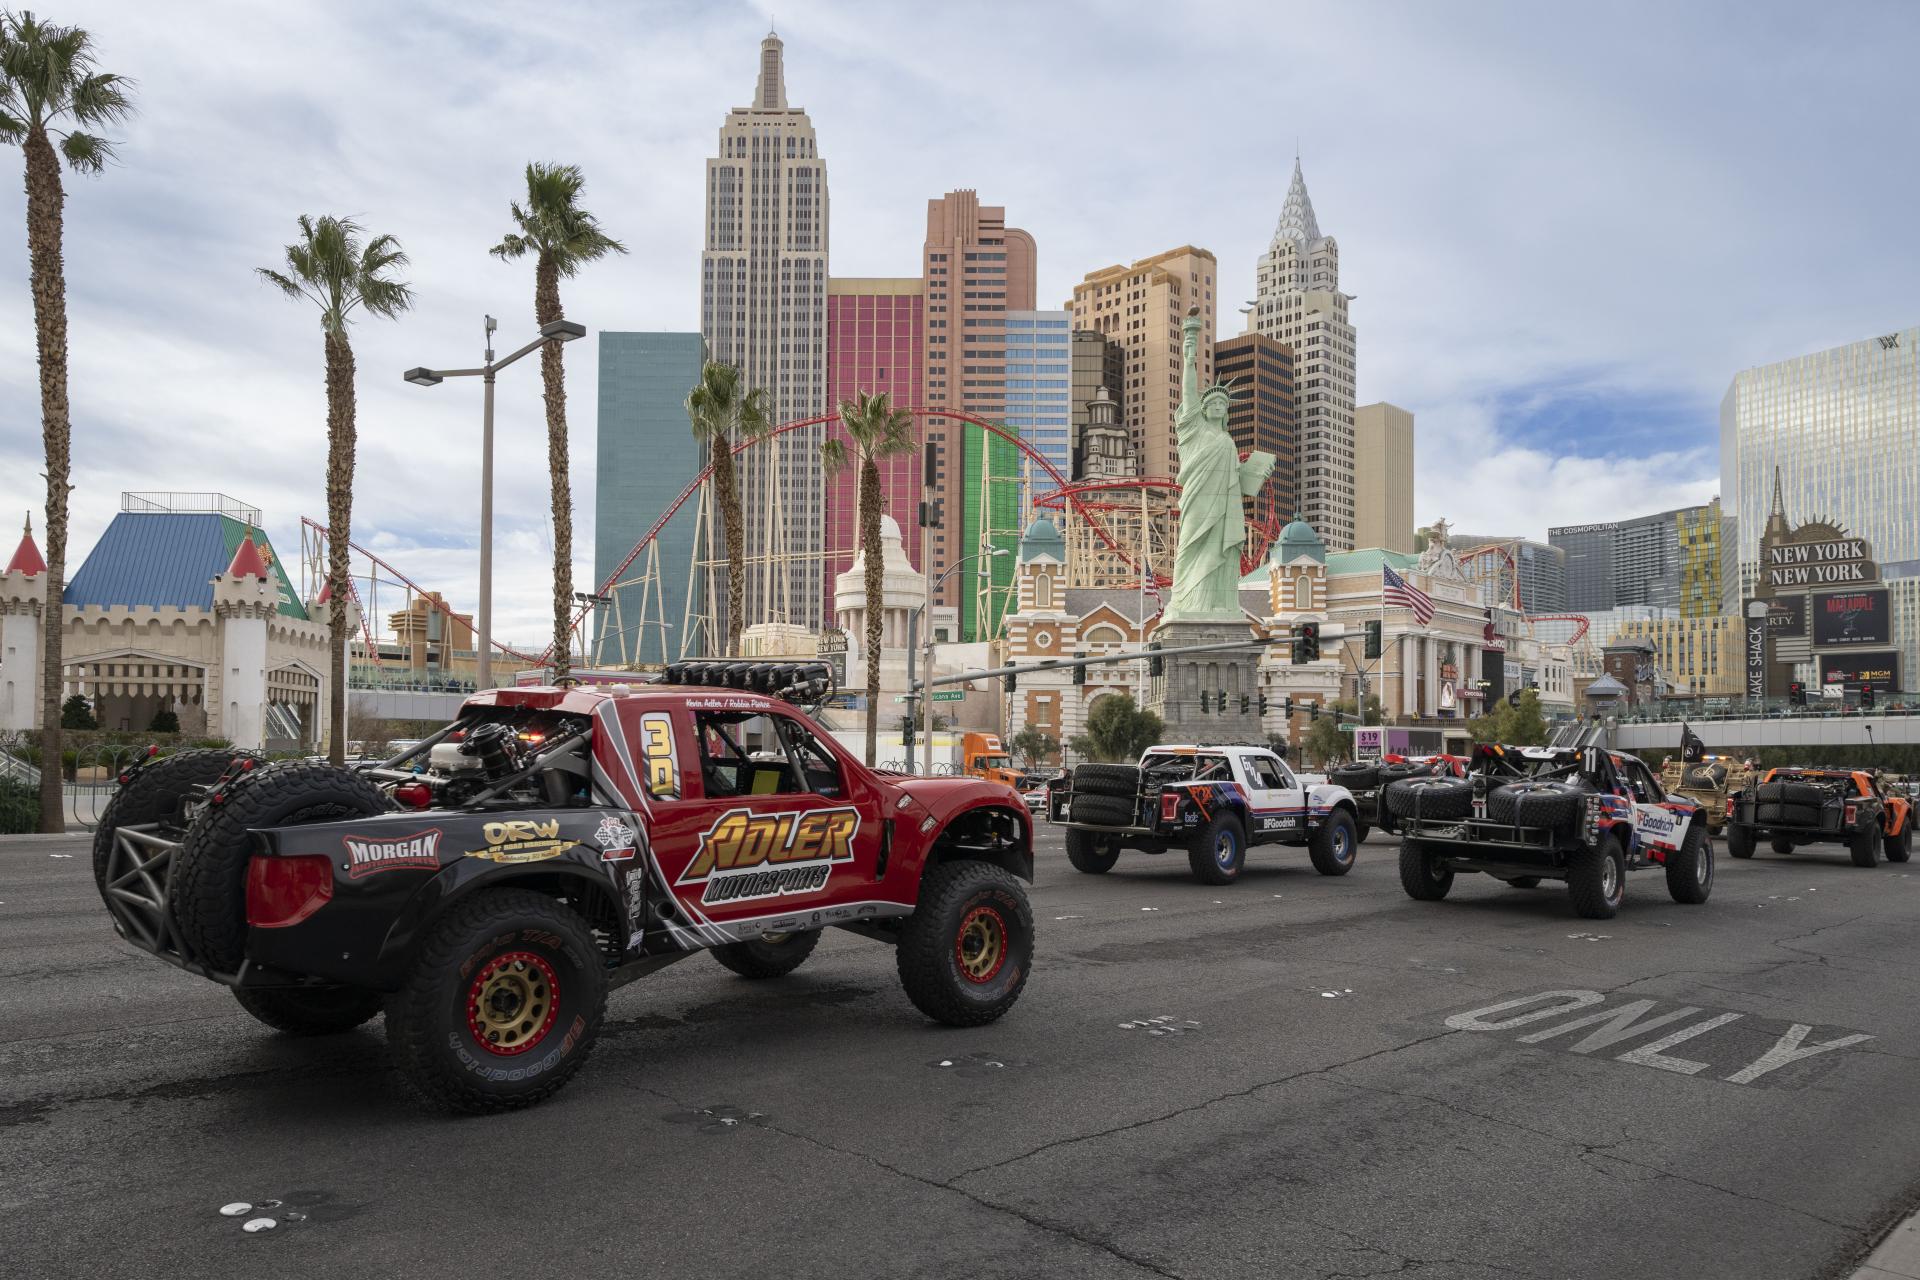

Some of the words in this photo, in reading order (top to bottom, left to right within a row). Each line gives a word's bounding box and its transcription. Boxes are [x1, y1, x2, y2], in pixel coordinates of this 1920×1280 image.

[1549, 528, 1561, 536] THE
[1563, 523, 1618, 535] COSMOPOLITAN
[1772, 545, 1810, 564] NEW
[1814, 541, 1864, 561] YORK
[1772, 567, 1810, 585] NEW
[1815, 563, 1864, 582] YORK
[817, 644, 829, 652] NEW
[830, 643, 846, 651] YORK
[1750, 626, 1762, 666] SHACK
[1361, 732, 1378, 741] $19
[644, 720, 674, 796] 30
[1583, 747, 1597, 773] 11
[482, 818, 560, 845] ORW
[1263, 818, 1296, 829] BFGoodrich
[346, 833, 439, 865] MORGAN
[680, 808, 860, 882] ADLER
[352, 857, 438, 873] MOTORSPORTS
[702, 864, 830, 902] MOTORSPORTS
[449, 1014, 586, 1082] BFGoodrich
[1444, 989, 1878, 1084] ONLY
